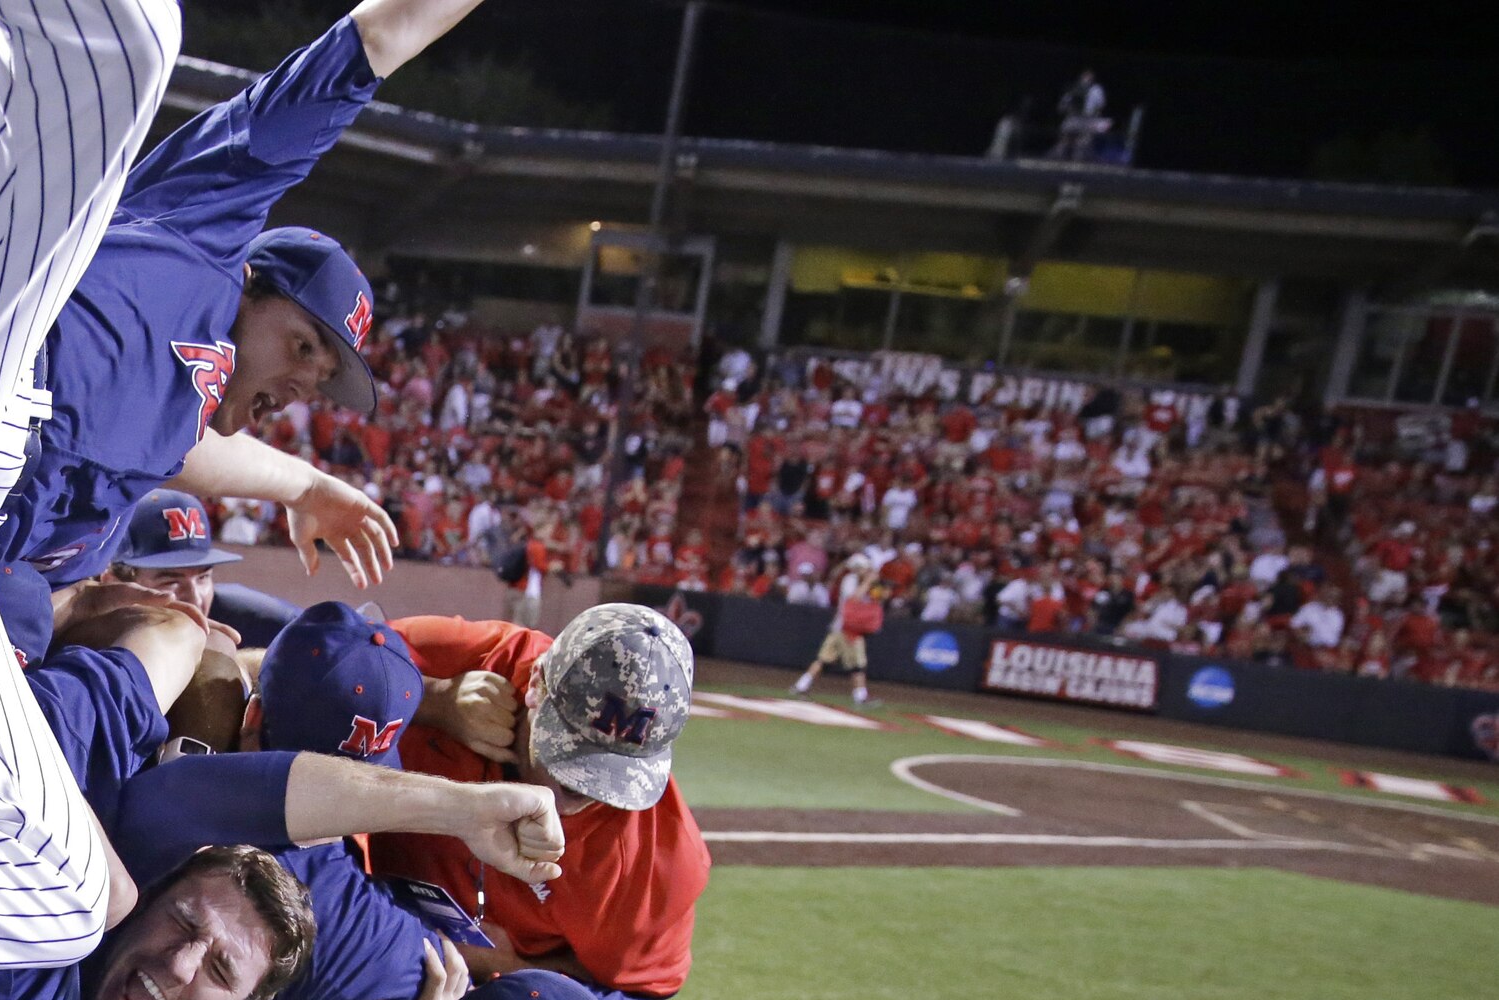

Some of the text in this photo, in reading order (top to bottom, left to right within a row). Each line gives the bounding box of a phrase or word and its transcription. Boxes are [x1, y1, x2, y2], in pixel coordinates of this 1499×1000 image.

[163, 507, 206, 541] M
[990, 641, 1157, 685] LOUISIANA
[338, 714, 404, 757] M
[592, 693, 657, 746] M
